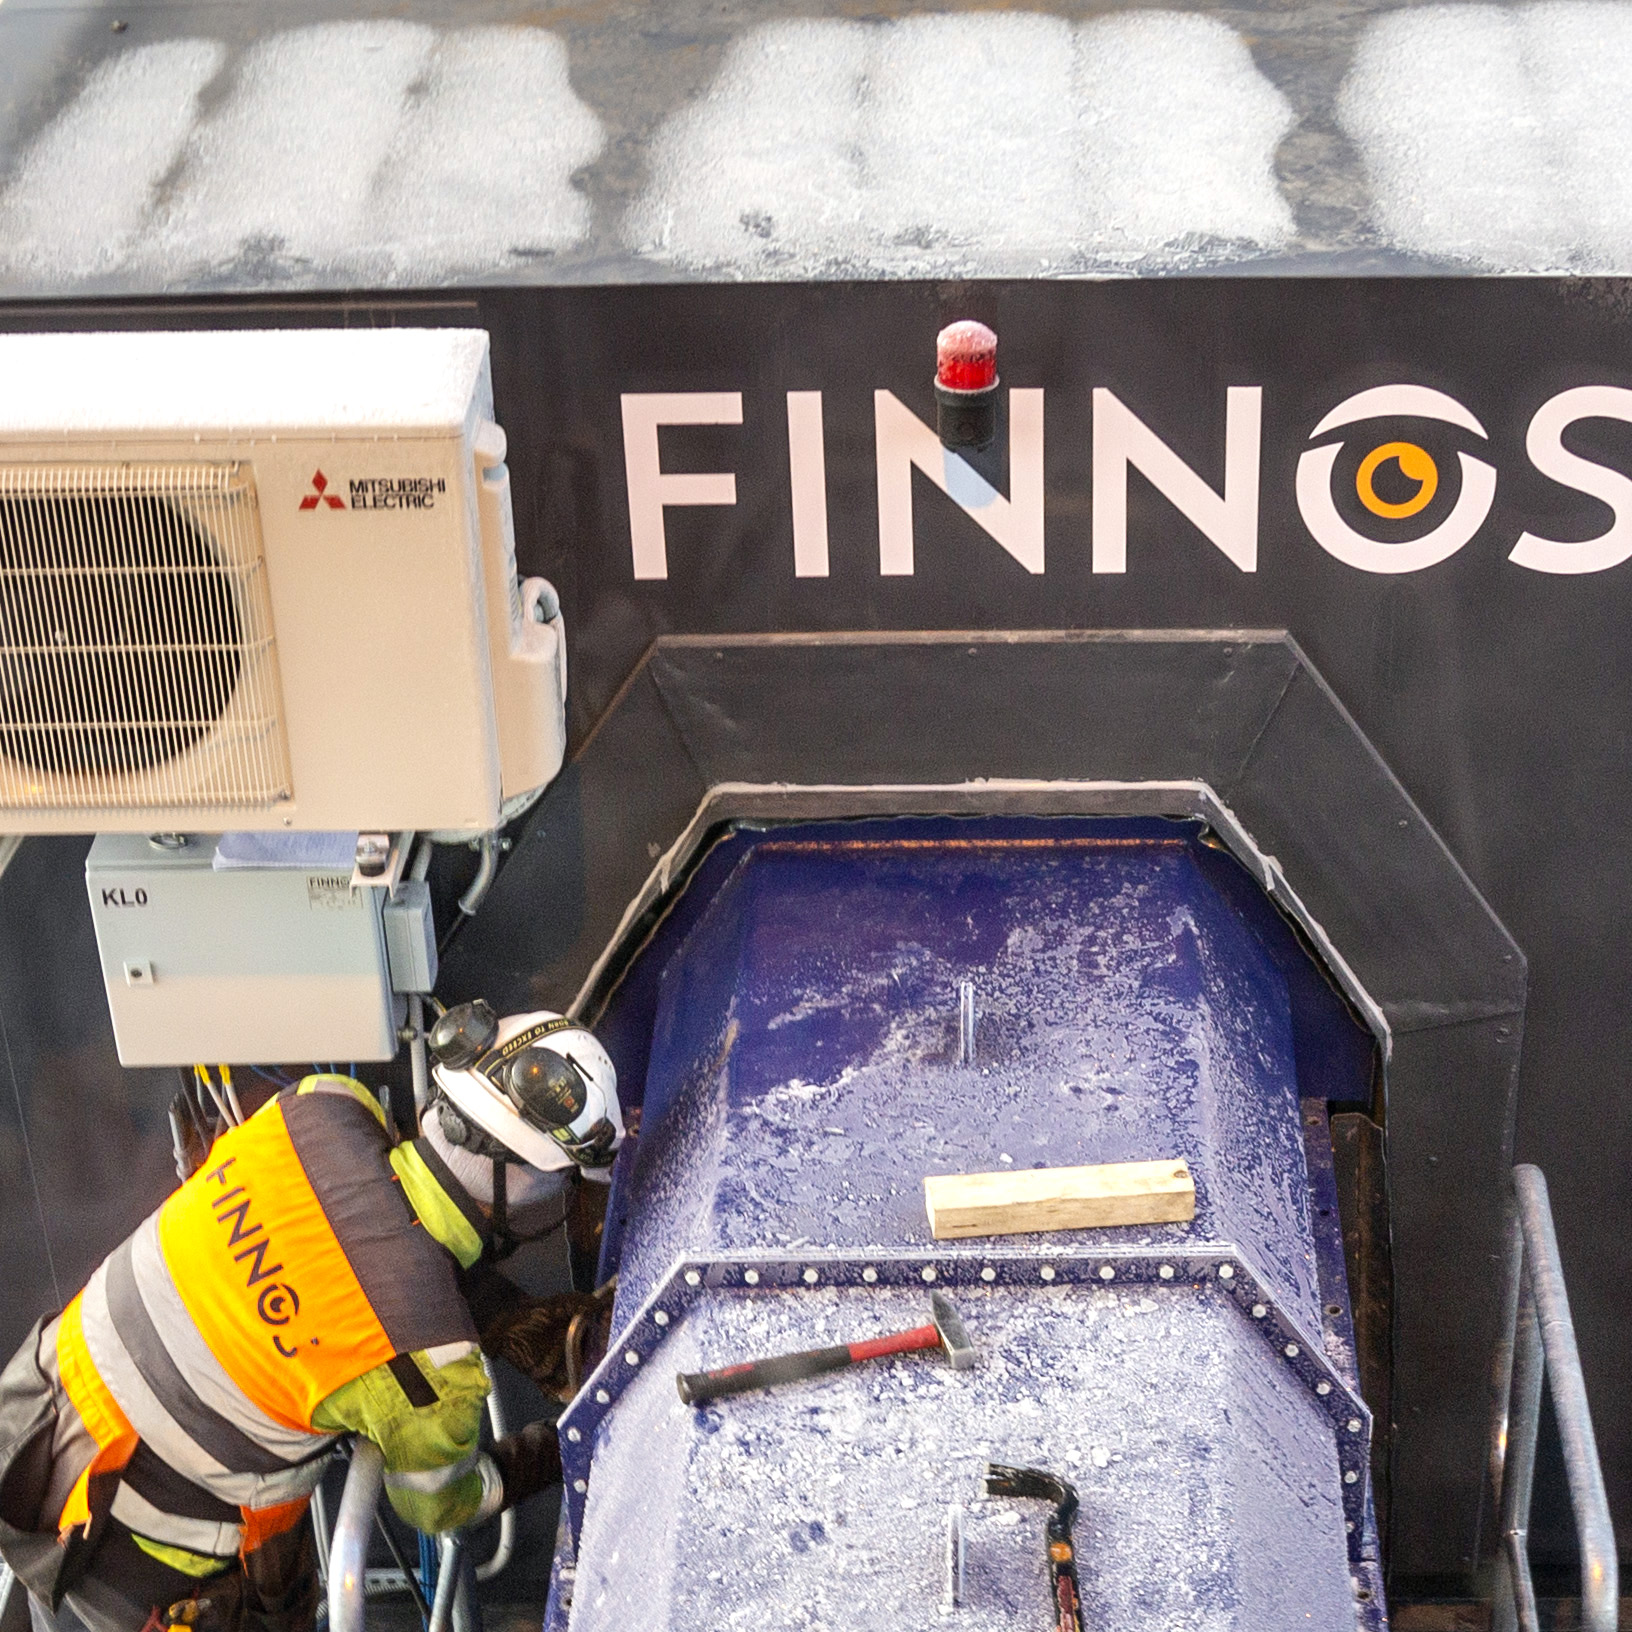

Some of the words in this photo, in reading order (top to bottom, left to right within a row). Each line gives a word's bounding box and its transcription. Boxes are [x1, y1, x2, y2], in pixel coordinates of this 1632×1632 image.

[349, 478, 446, 494] MITSUBISHI
[351, 494, 435, 511] ELECTRIC
[309, 876, 350, 889] FINNO
